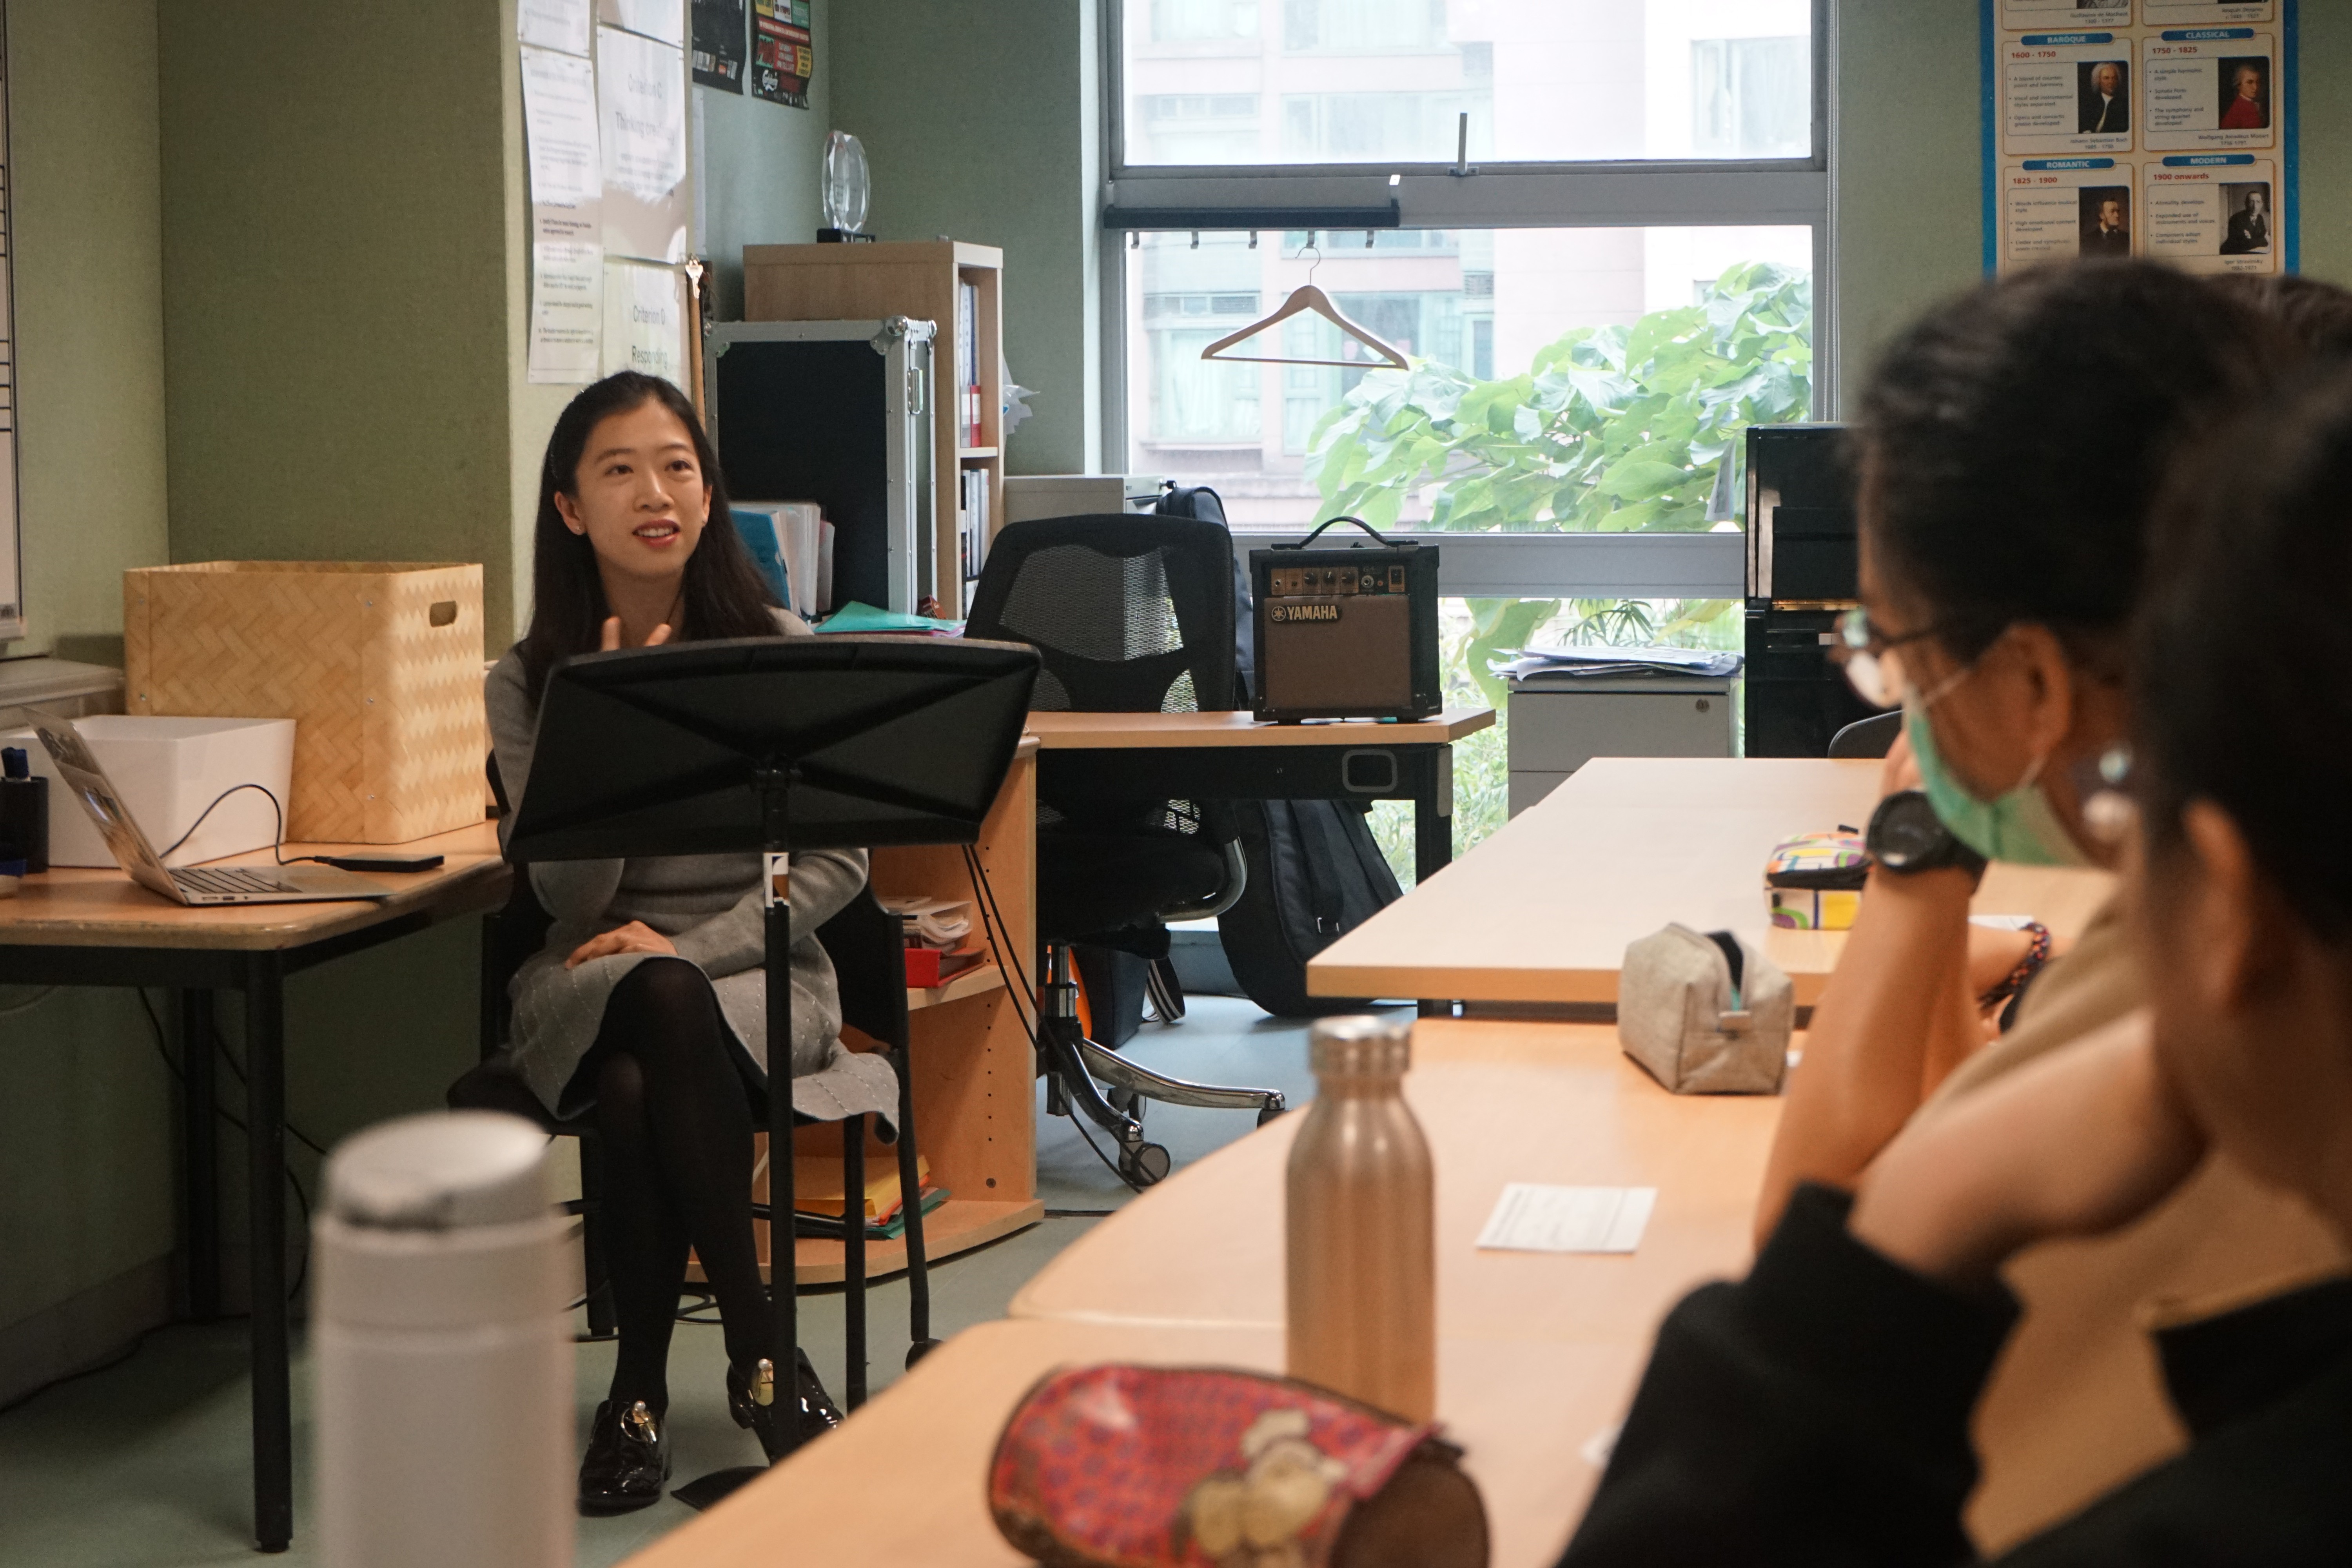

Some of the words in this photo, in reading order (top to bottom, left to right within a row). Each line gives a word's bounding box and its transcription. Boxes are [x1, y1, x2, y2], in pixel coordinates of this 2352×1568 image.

[657, 82, 662, 99] C
[633, 305, 660, 325] Criterion
[632, 345, 668, 370] Responding
[1287, 605, 1338, 621] YAMAHA
